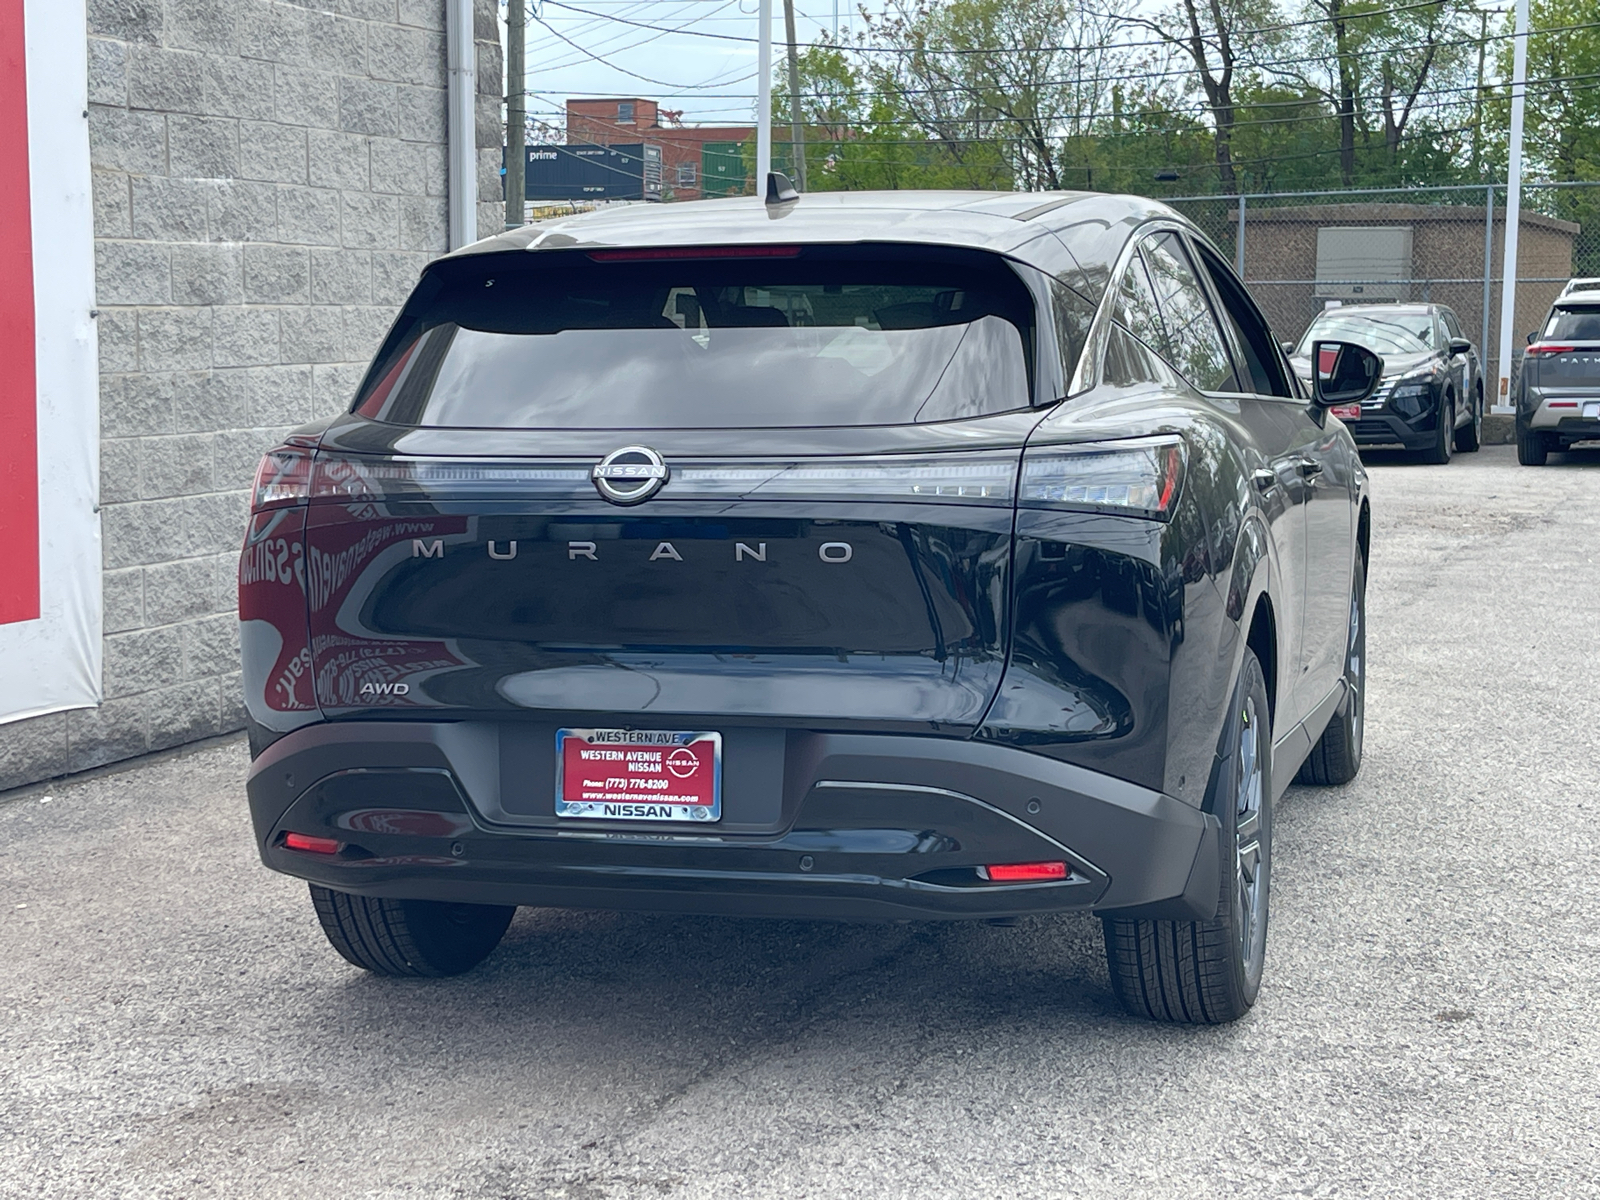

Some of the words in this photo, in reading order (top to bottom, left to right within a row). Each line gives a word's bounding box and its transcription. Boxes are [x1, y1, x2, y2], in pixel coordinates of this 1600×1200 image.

[529, 150, 557, 162] prime
[594, 467, 664, 477] NISSAN
[412, 540, 853, 563] MURANO
[360, 682, 409, 695] AWD
[595, 731, 652, 743] WESTERN
[657, 734, 680, 744] AVE
[580, 750, 624, 761] WESTERN
[626, 752, 662, 762] AVENUE
[628, 762, 662, 772] NISSAN
[605, 778, 627, 790] (773)
[629, 778, 669, 790] 776-8200
[581, 791, 699, 803] www.westernavenissan.com
[604, 804, 672, 818] NISSAN
